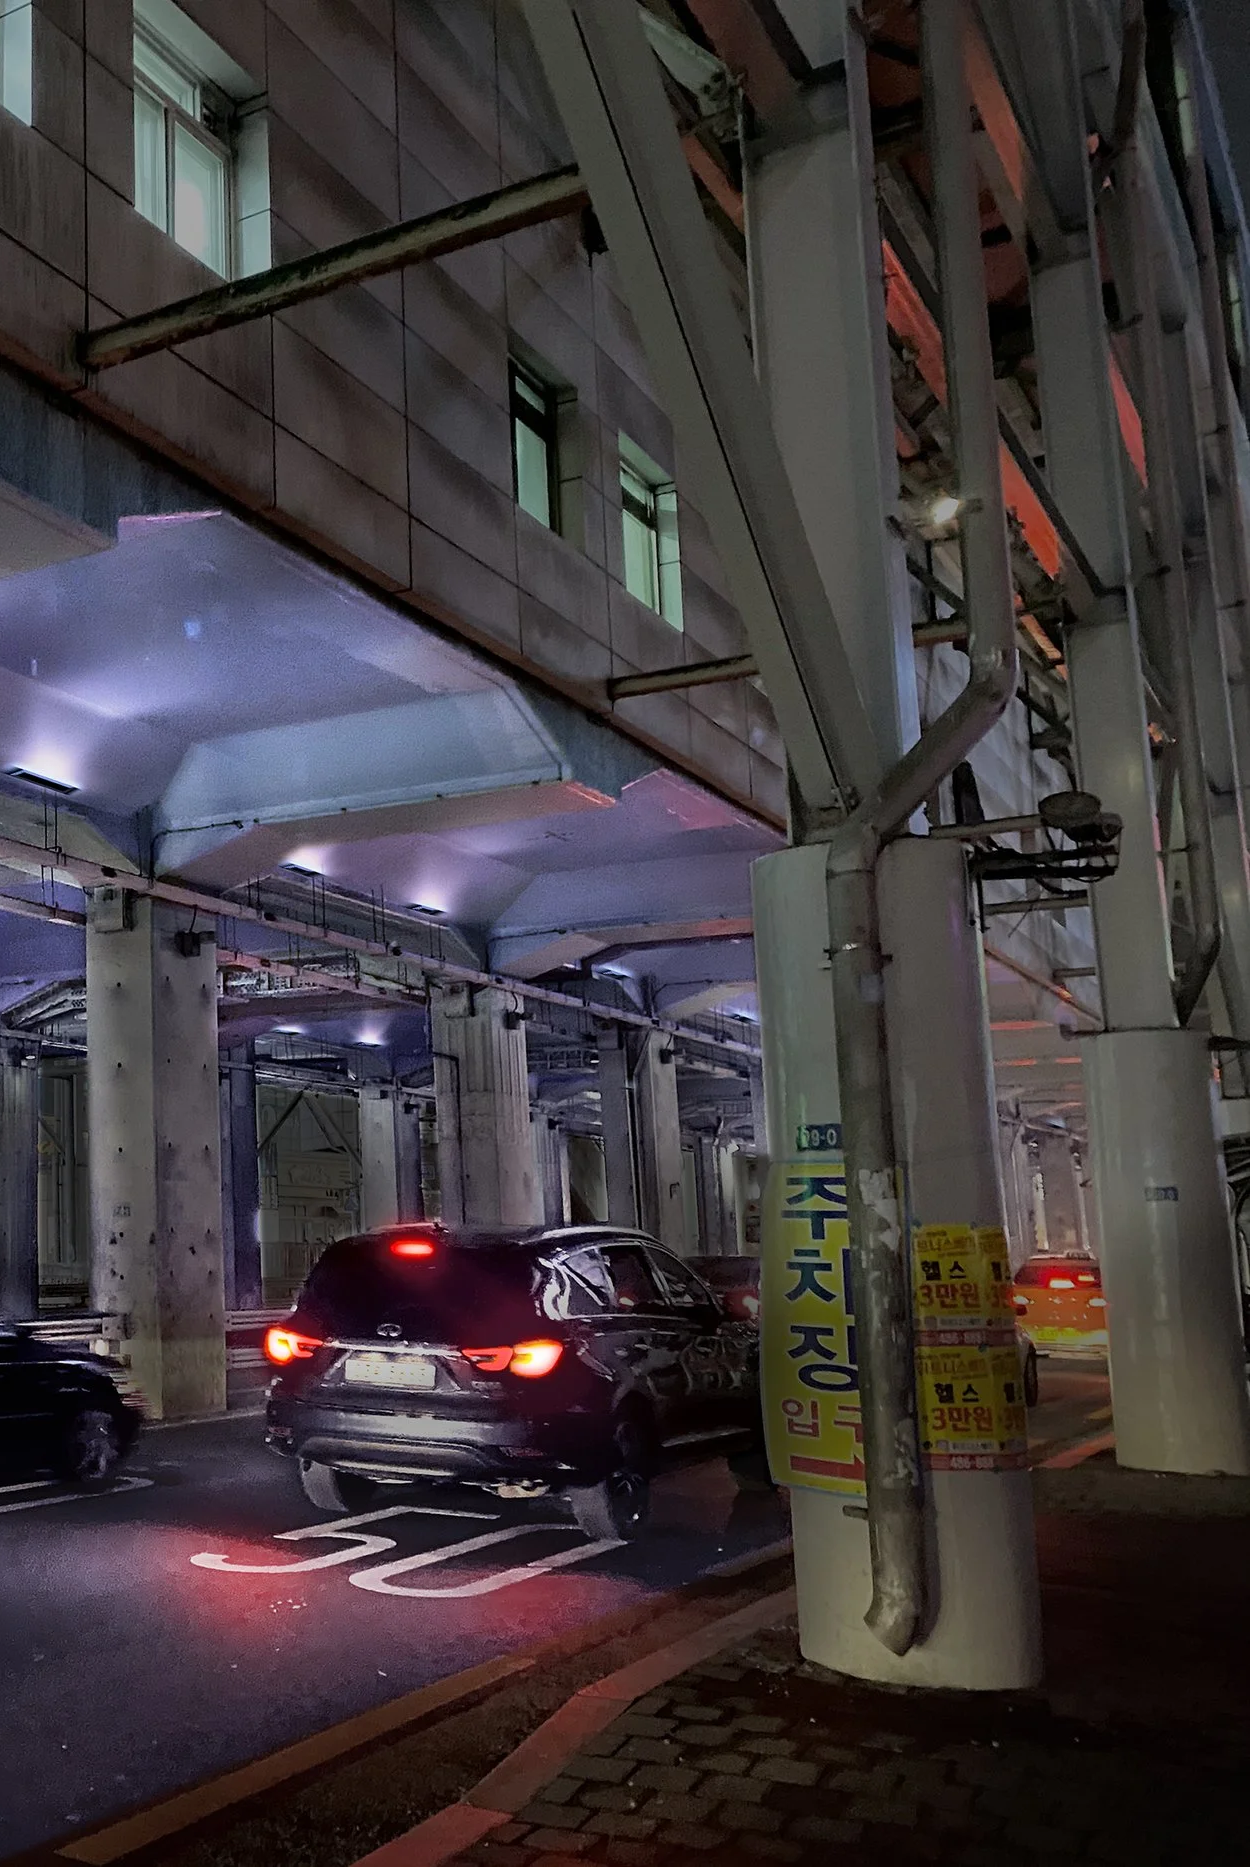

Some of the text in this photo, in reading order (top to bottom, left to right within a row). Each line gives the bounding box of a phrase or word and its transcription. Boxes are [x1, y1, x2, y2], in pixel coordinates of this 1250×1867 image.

[919, 1282, 981, 1309] 3만원
[932, 1405, 995, 1432] 3만원
[190, 1505, 629, 1598] 50
